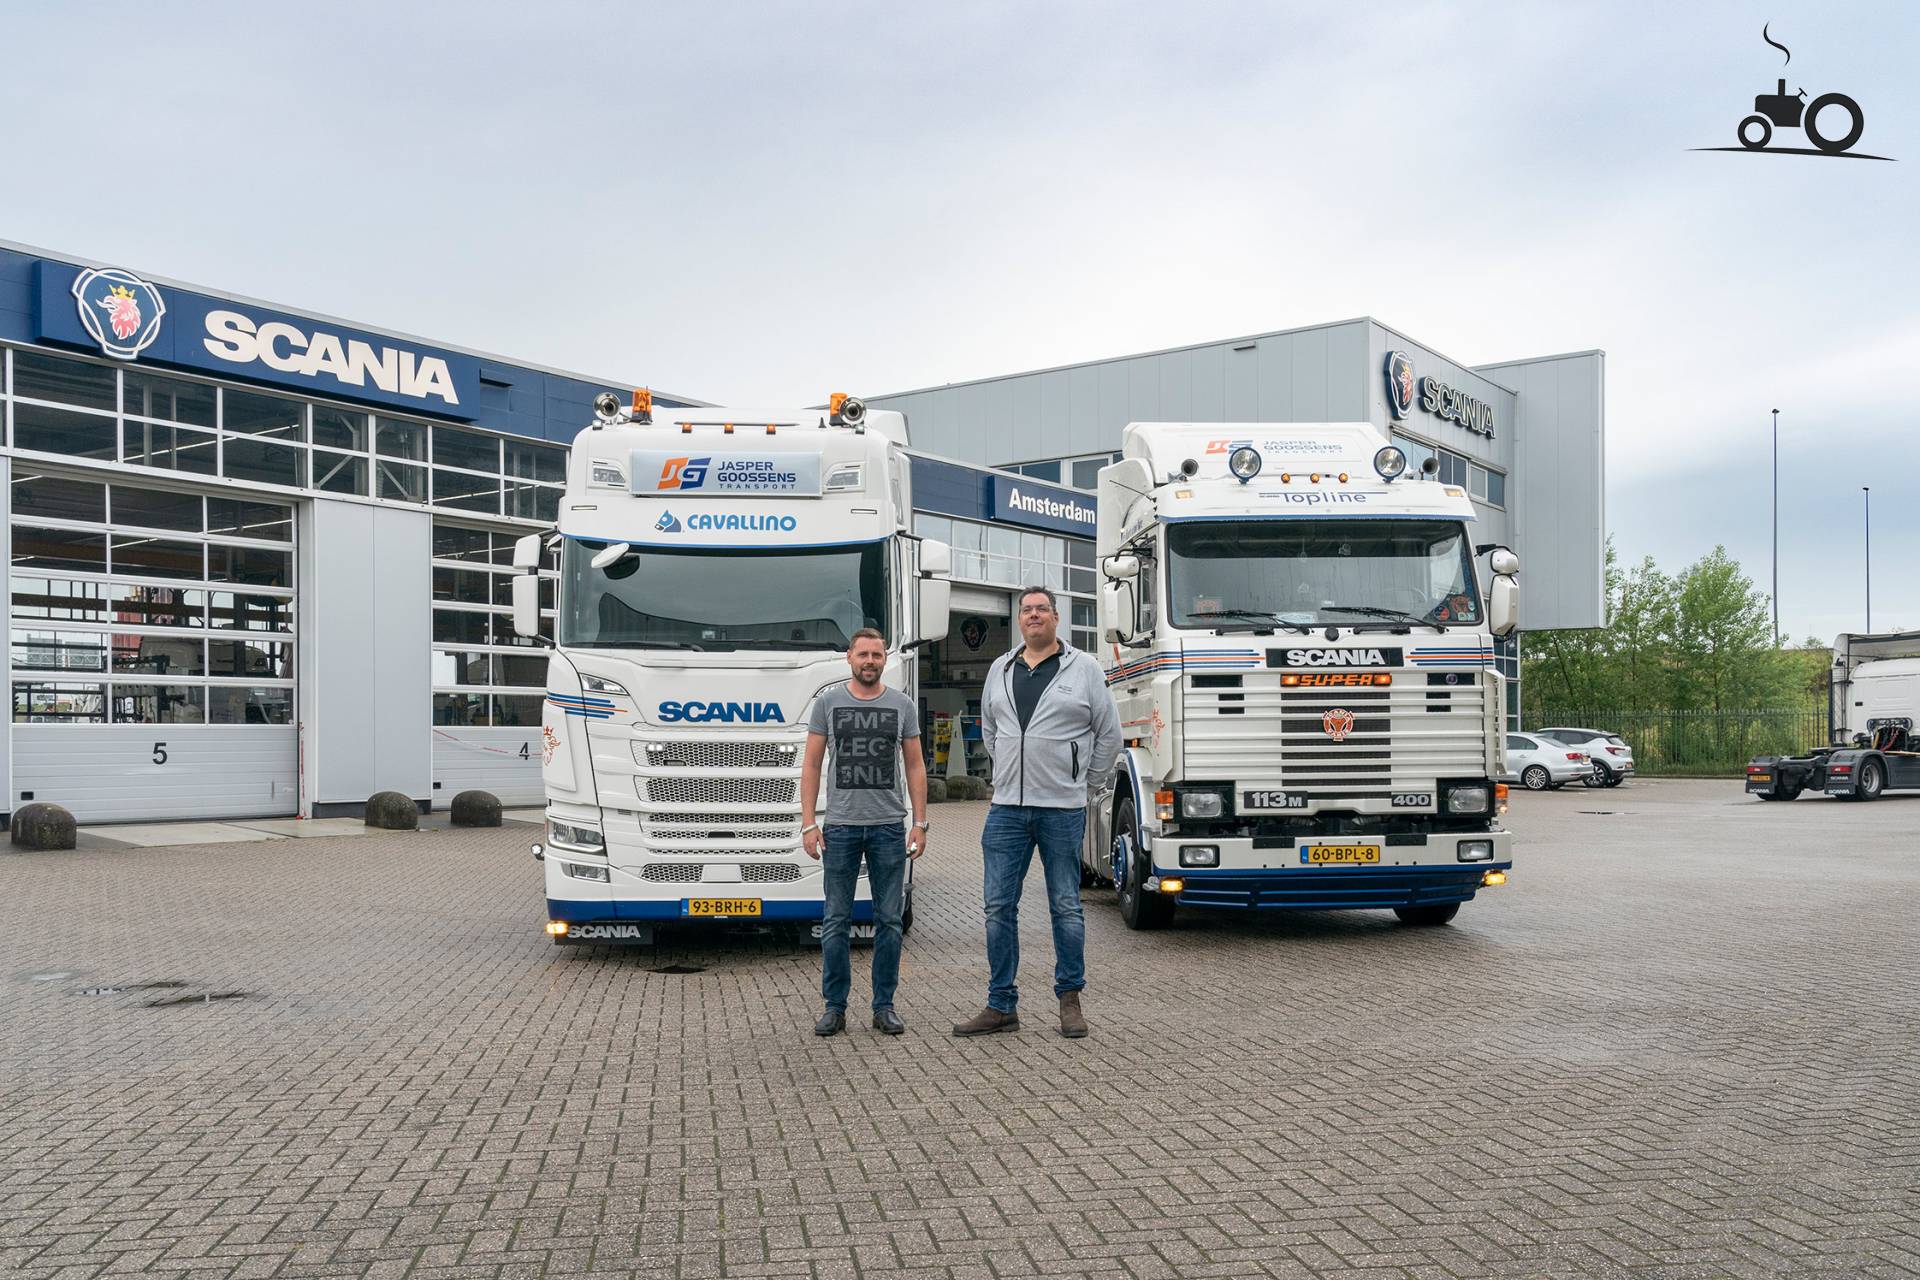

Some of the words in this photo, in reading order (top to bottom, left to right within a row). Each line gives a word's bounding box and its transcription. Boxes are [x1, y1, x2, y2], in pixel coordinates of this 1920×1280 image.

[203, 310, 460, 405] SCANIA
[1419, 376, 1496, 439] SCANIA
[717, 461, 773, 471] JASPER
[717, 472, 797, 483] GOOSSENS
[1008, 487, 1096, 524] Amsterdam
[1282, 491, 1367, 505] Topline
[687, 513, 797, 532] CAVALLINO
[1286, 649, 1386, 666] SCANIA
[1299, 674, 1374, 686] SUPER
[657, 701, 786, 722] SCANIA
[152, 742, 168, 765] 5
[519, 742, 530, 760] 4
[1393, 794, 1430, 806] 400
[1313, 848, 1374, 861] 60-BPL-8
[693, 901, 757, 913] 93-BRH-6
[567, 925, 641, 938] SCANIA
